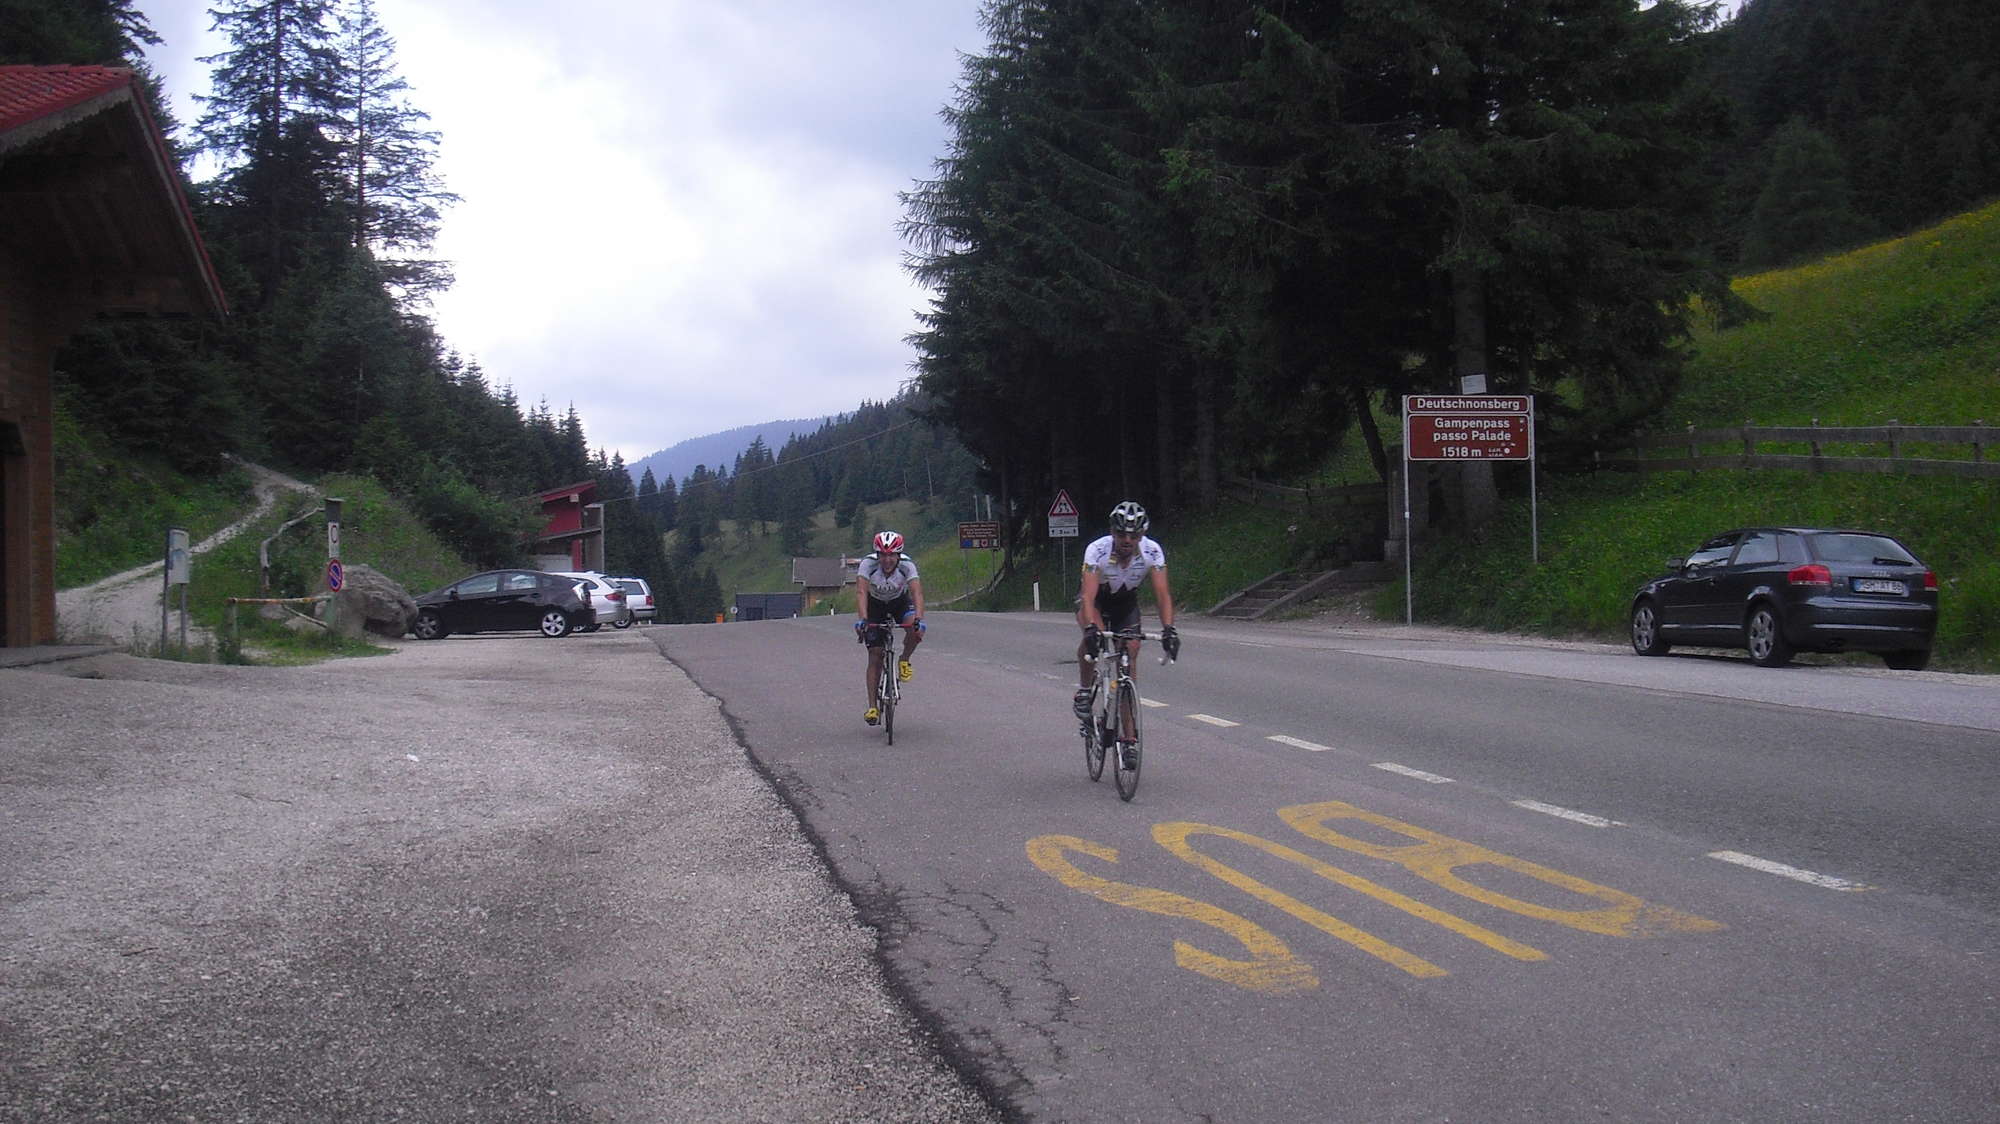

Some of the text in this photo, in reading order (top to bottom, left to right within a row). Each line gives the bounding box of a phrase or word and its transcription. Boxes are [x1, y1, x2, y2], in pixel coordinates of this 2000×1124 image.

[1417, 398, 1520, 410] Deutschnonsberg
[1434, 417, 1510, 429] Gampenpass
[1433, 430, 1511, 442] passo Palade
[1442, 446, 1468, 457] 1518
[1471, 448, 1482, 457] m
[1025, 800, 1715, 997] BUS
